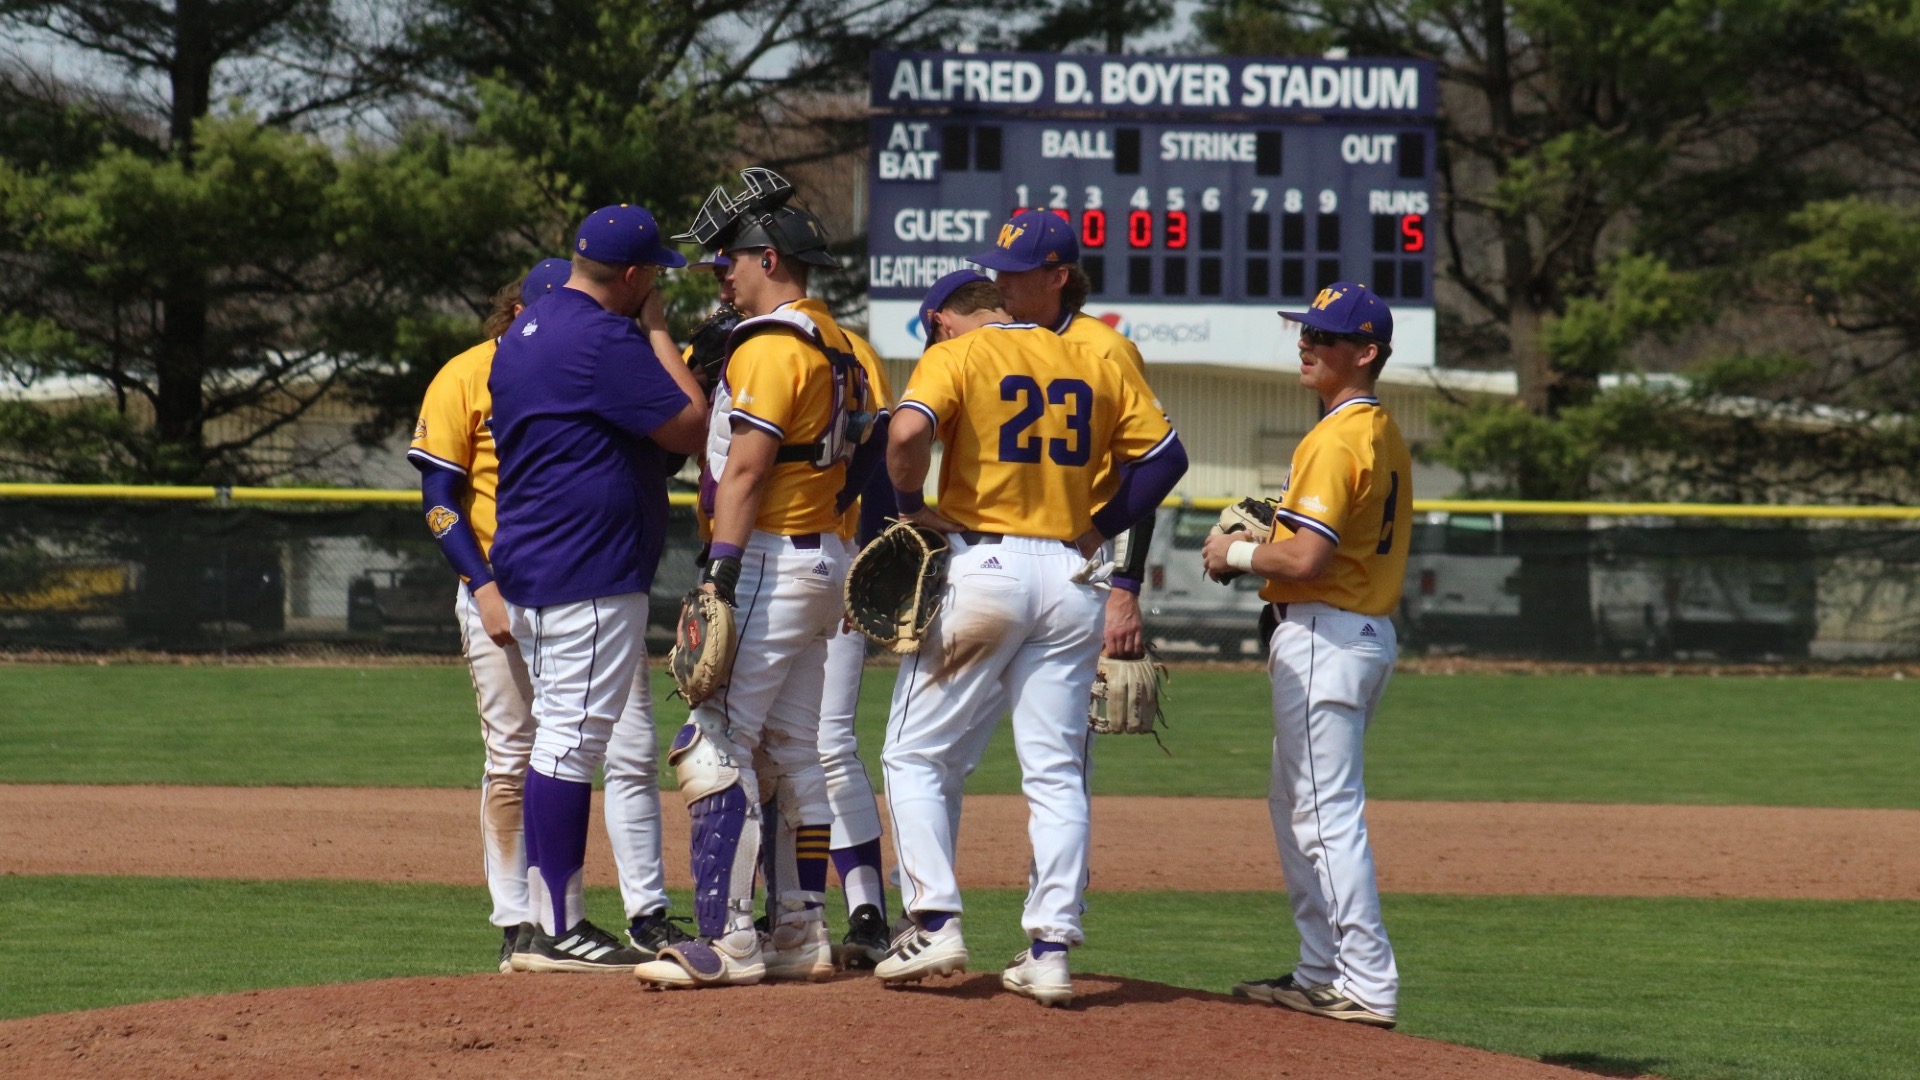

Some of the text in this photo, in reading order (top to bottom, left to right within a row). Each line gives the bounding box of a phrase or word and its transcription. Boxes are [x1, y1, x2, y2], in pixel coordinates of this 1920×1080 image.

[889, 60, 1418, 109] ALFRED D. BOYER STADIUM
[888, 123, 930, 150] AT
[1042, 130, 1114, 159] BALL
[1160, 132, 1257, 161] STRIKE
[1342, 135, 1396, 164] OUT
[879, 152, 939, 179] BAT
[1016, 185, 1429, 214] 1 2 3 4 5 6 7 8 9 RUNS
[894, 209, 1424, 251] GUEST 0 0 3 5
[996, 223, 1024, 249] W
[1311, 288, 1343, 310] W
[1134, 317, 1211, 346] pepsi
[998, 374, 1093, 467] 23
